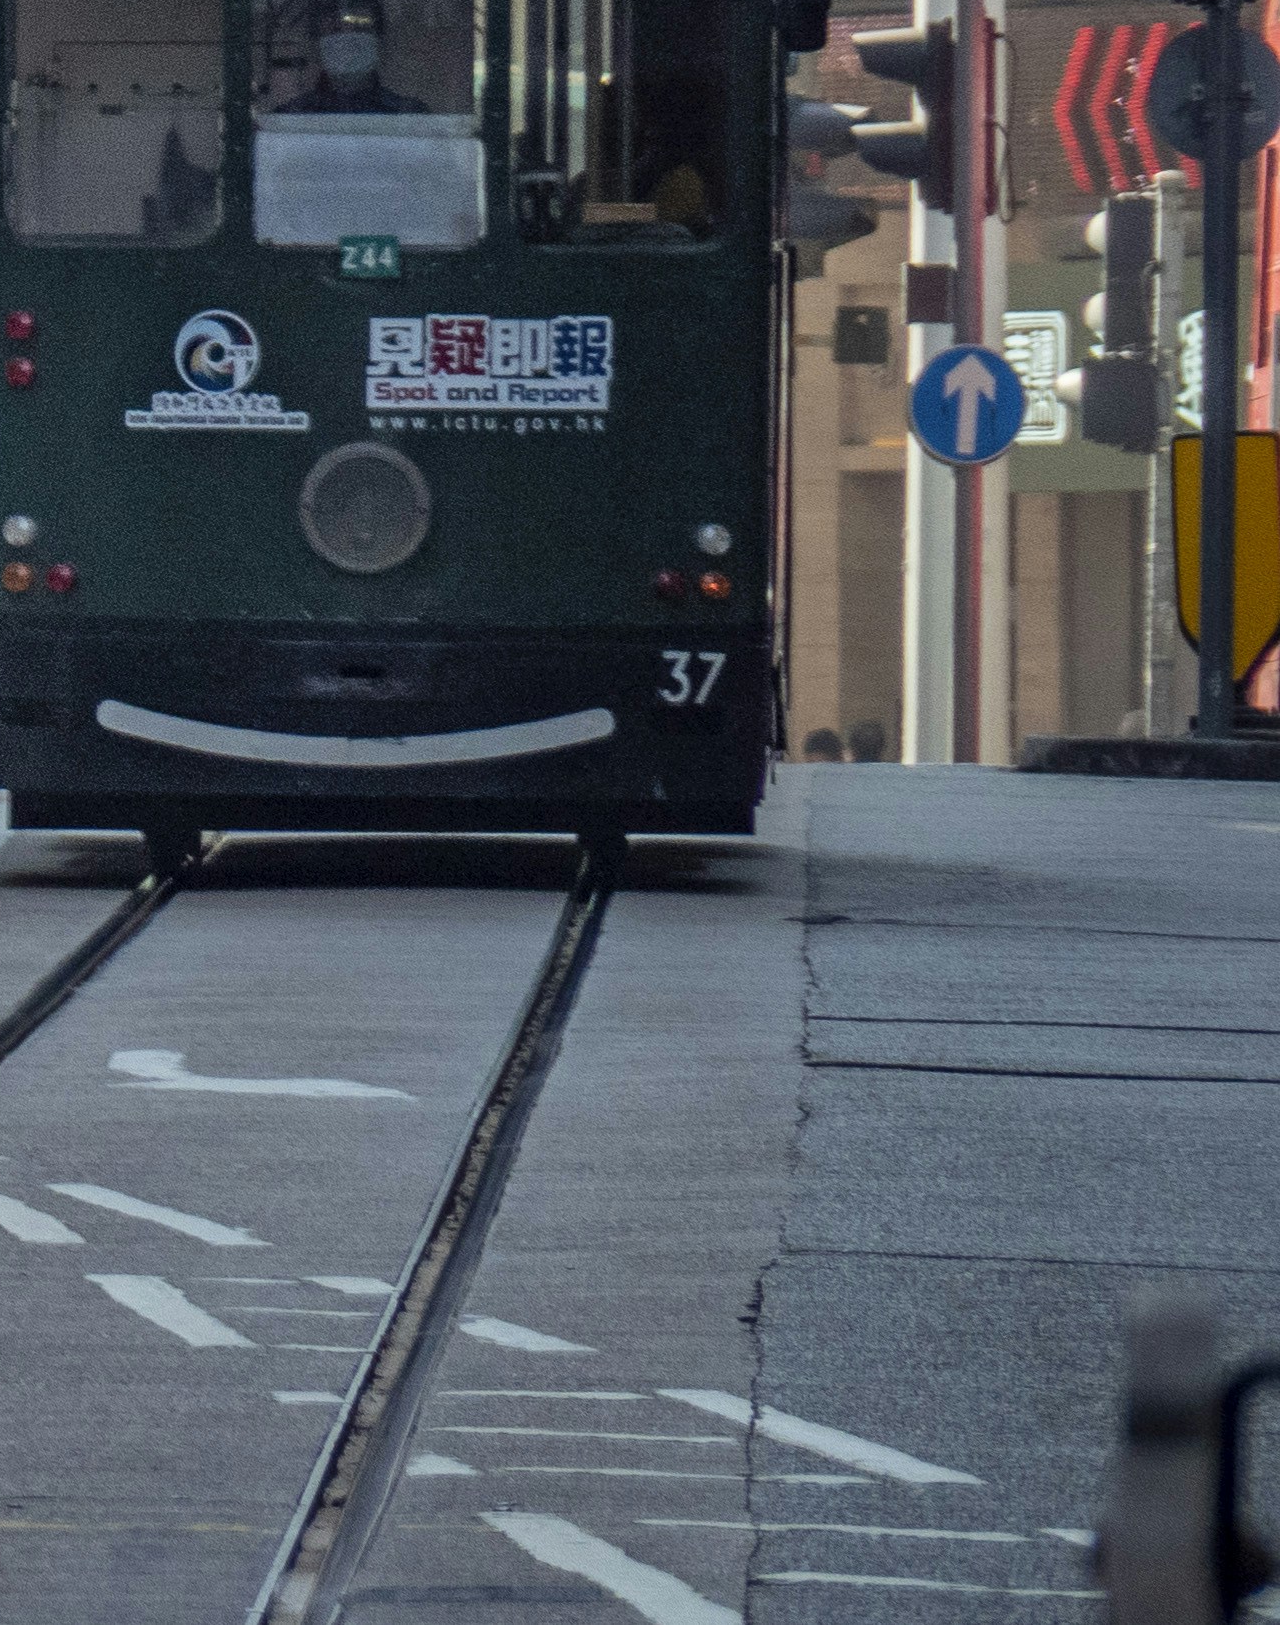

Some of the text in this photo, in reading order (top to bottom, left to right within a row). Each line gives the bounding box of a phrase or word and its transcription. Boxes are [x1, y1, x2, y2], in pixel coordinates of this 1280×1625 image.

[341, 245, 394, 269] Z44
[366, 314, 613, 378] 見疑即報
[373, 381, 601, 406] Spot and Report
[656, 650, 728, 707] 37
